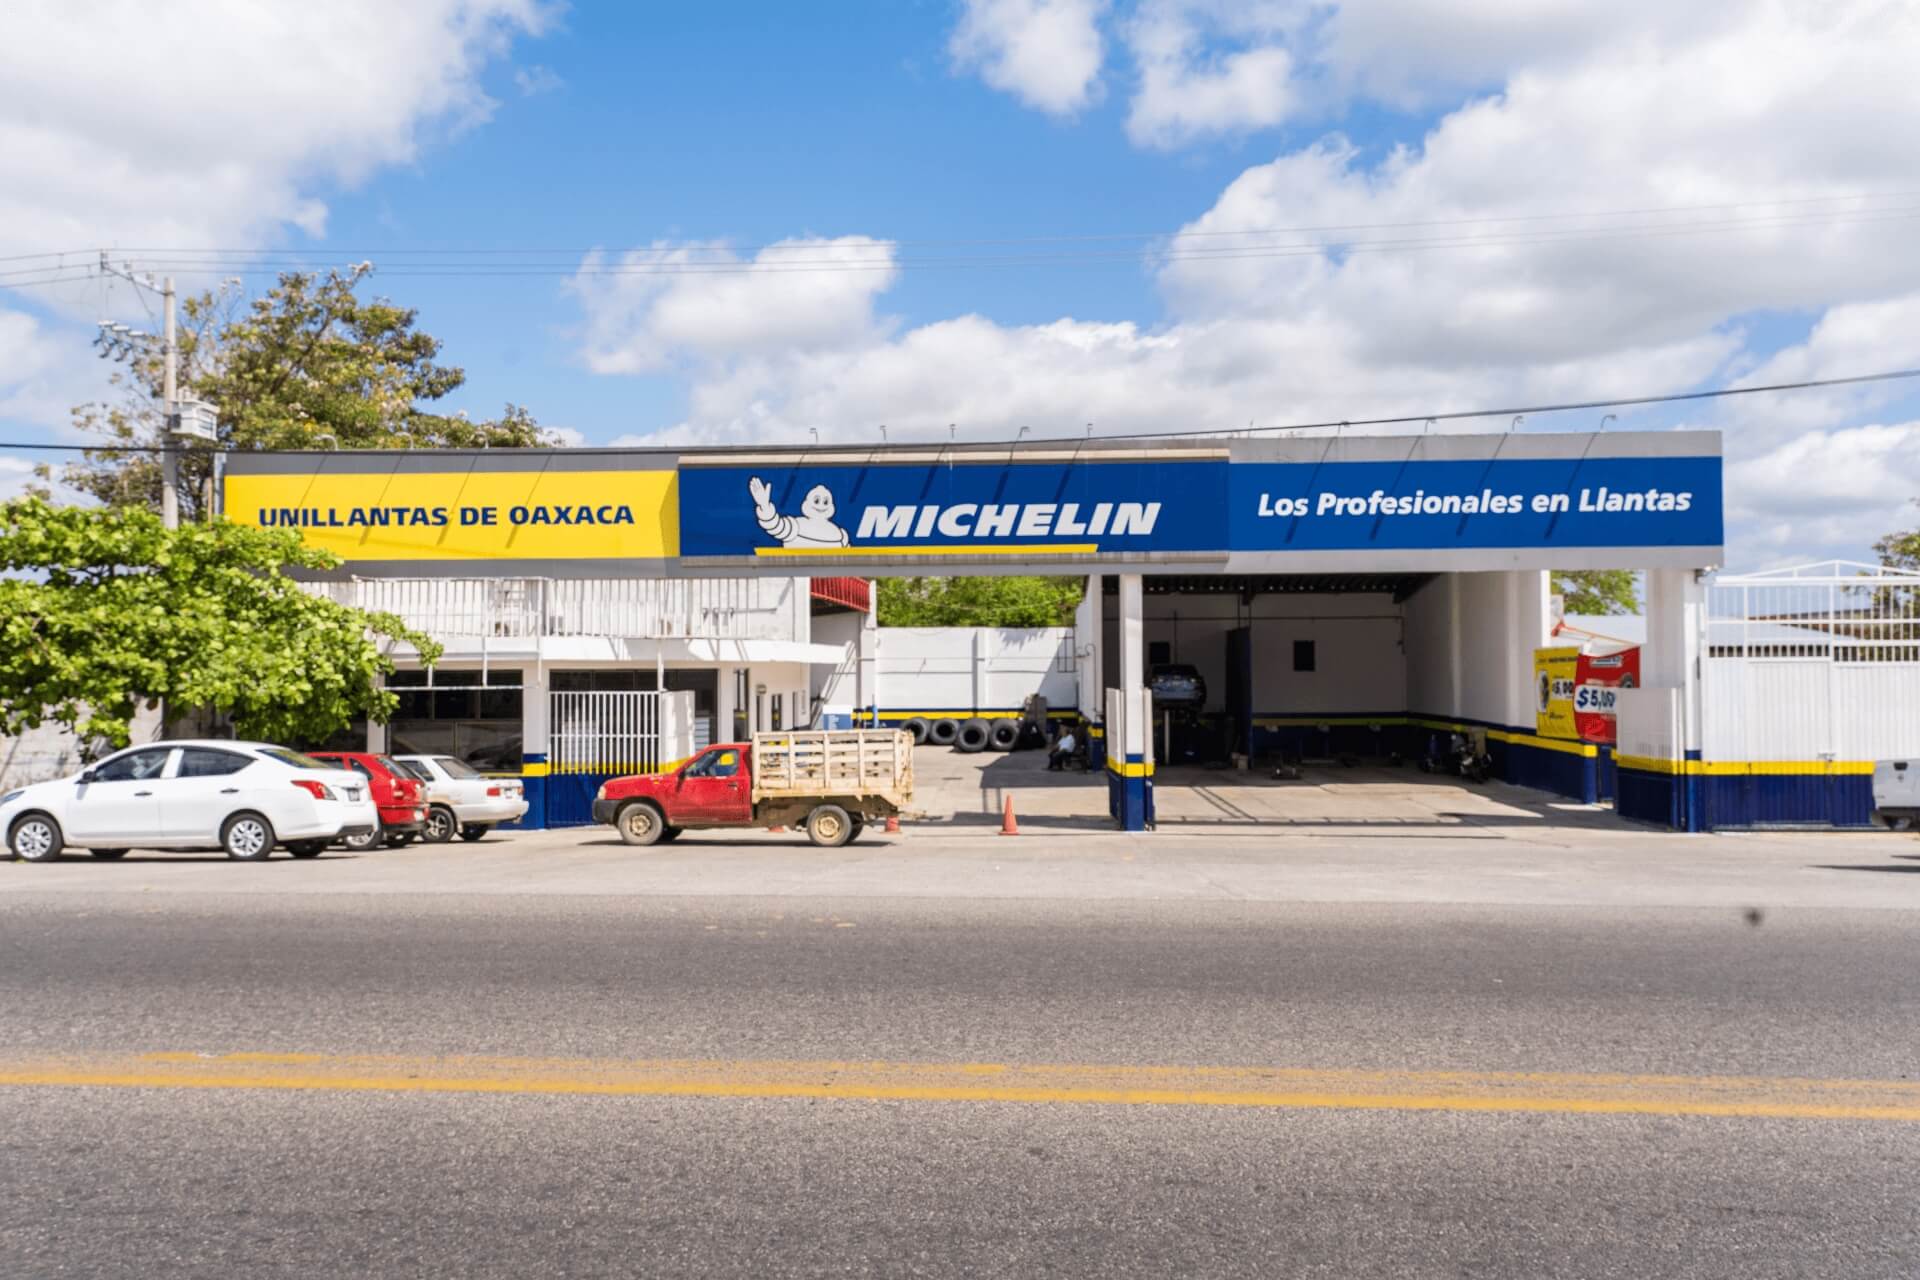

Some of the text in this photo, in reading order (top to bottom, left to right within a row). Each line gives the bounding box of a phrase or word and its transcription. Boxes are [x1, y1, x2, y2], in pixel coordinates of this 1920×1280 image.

[259, 505, 634, 527] UNILLANTAS DE OAXACA
[1259, 488, 1692, 517] Los Profesionales en Llantas
[856, 502, 1161, 538] MICHELIN
